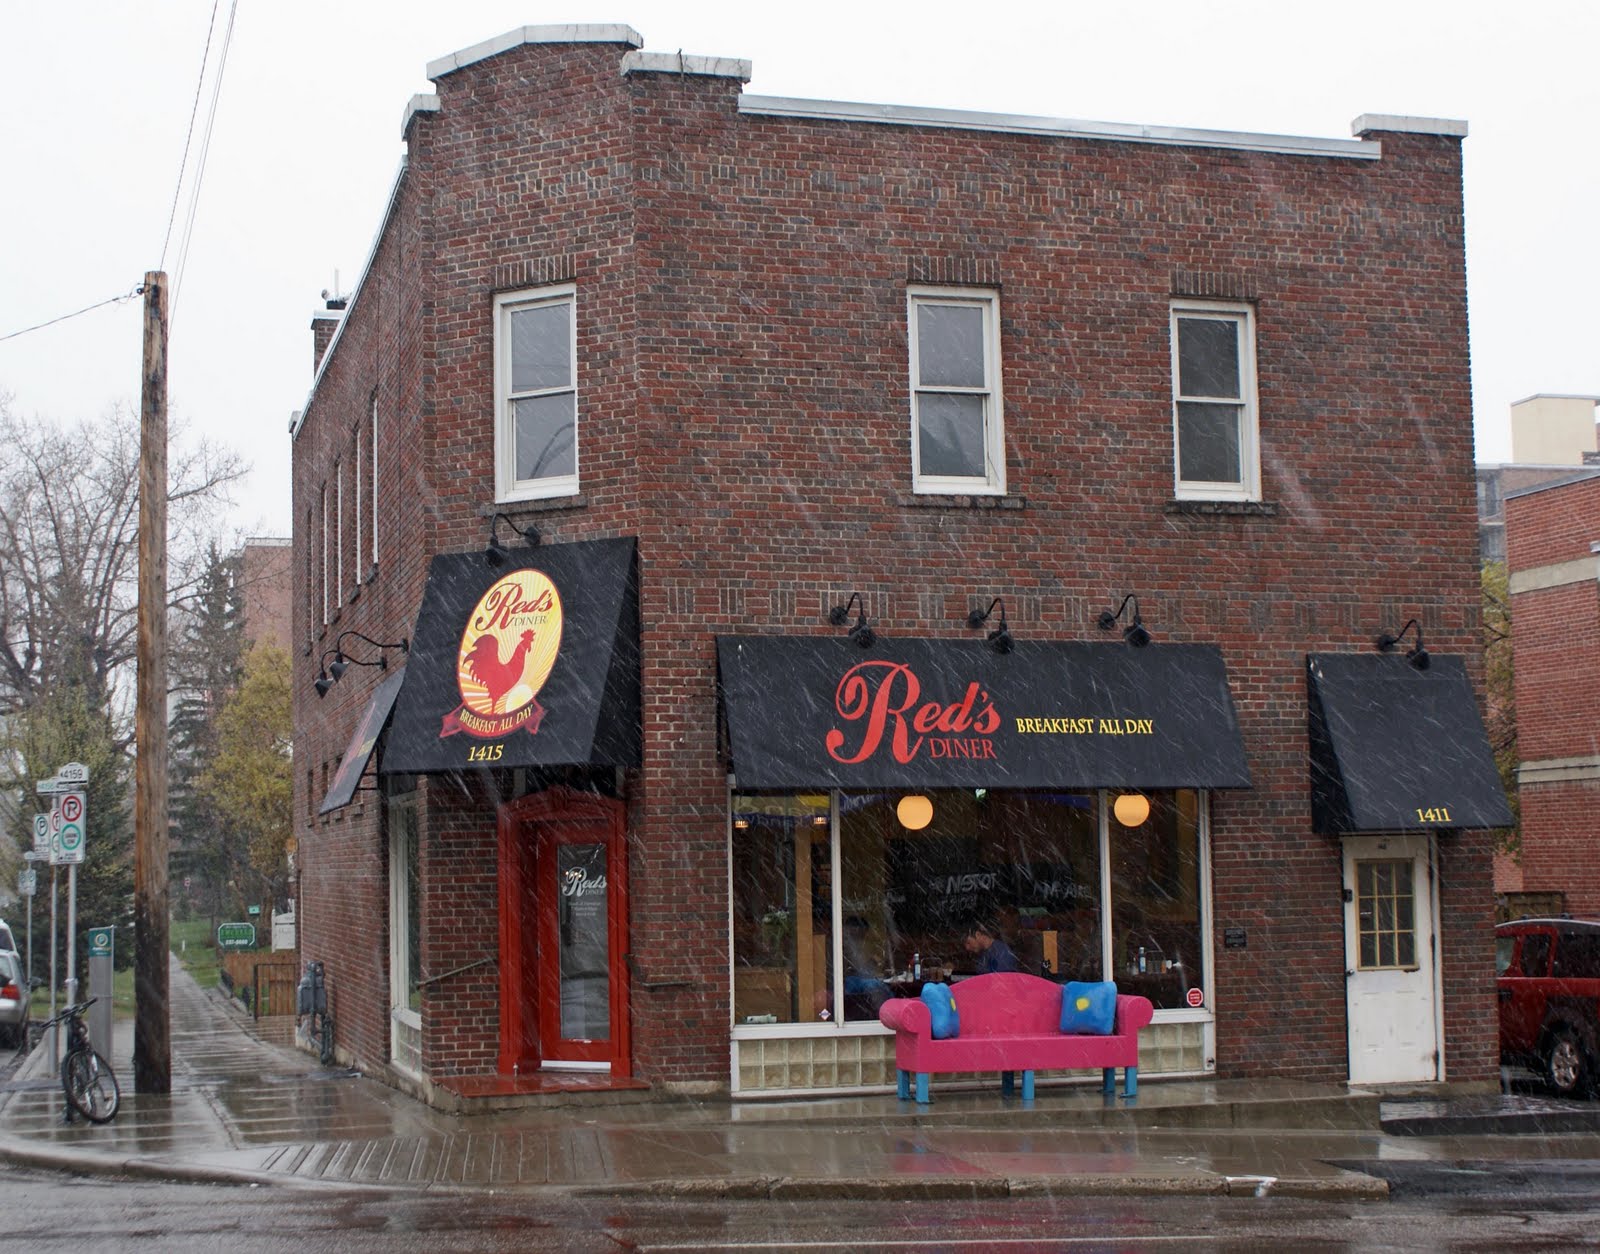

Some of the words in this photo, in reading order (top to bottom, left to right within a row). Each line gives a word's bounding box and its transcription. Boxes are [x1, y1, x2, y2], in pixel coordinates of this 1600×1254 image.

[514, 615, 547, 627] DINER
[459, 707, 497, 733] BREAKFAST
[499, 715, 513, 731] ALL
[516, 704, 533, 724] DAY
[826, 660, 1001, 764] Red's
[1016, 717, 1094, 735] BREAKFAST
[1099, 718, 1124, 735] ALL
[1125, 719, 1154, 735] DAY
[467, 744, 504, 761] 1415
[930, 737, 998, 760] DINER
[1415, 807, 1452, 823] 1411
